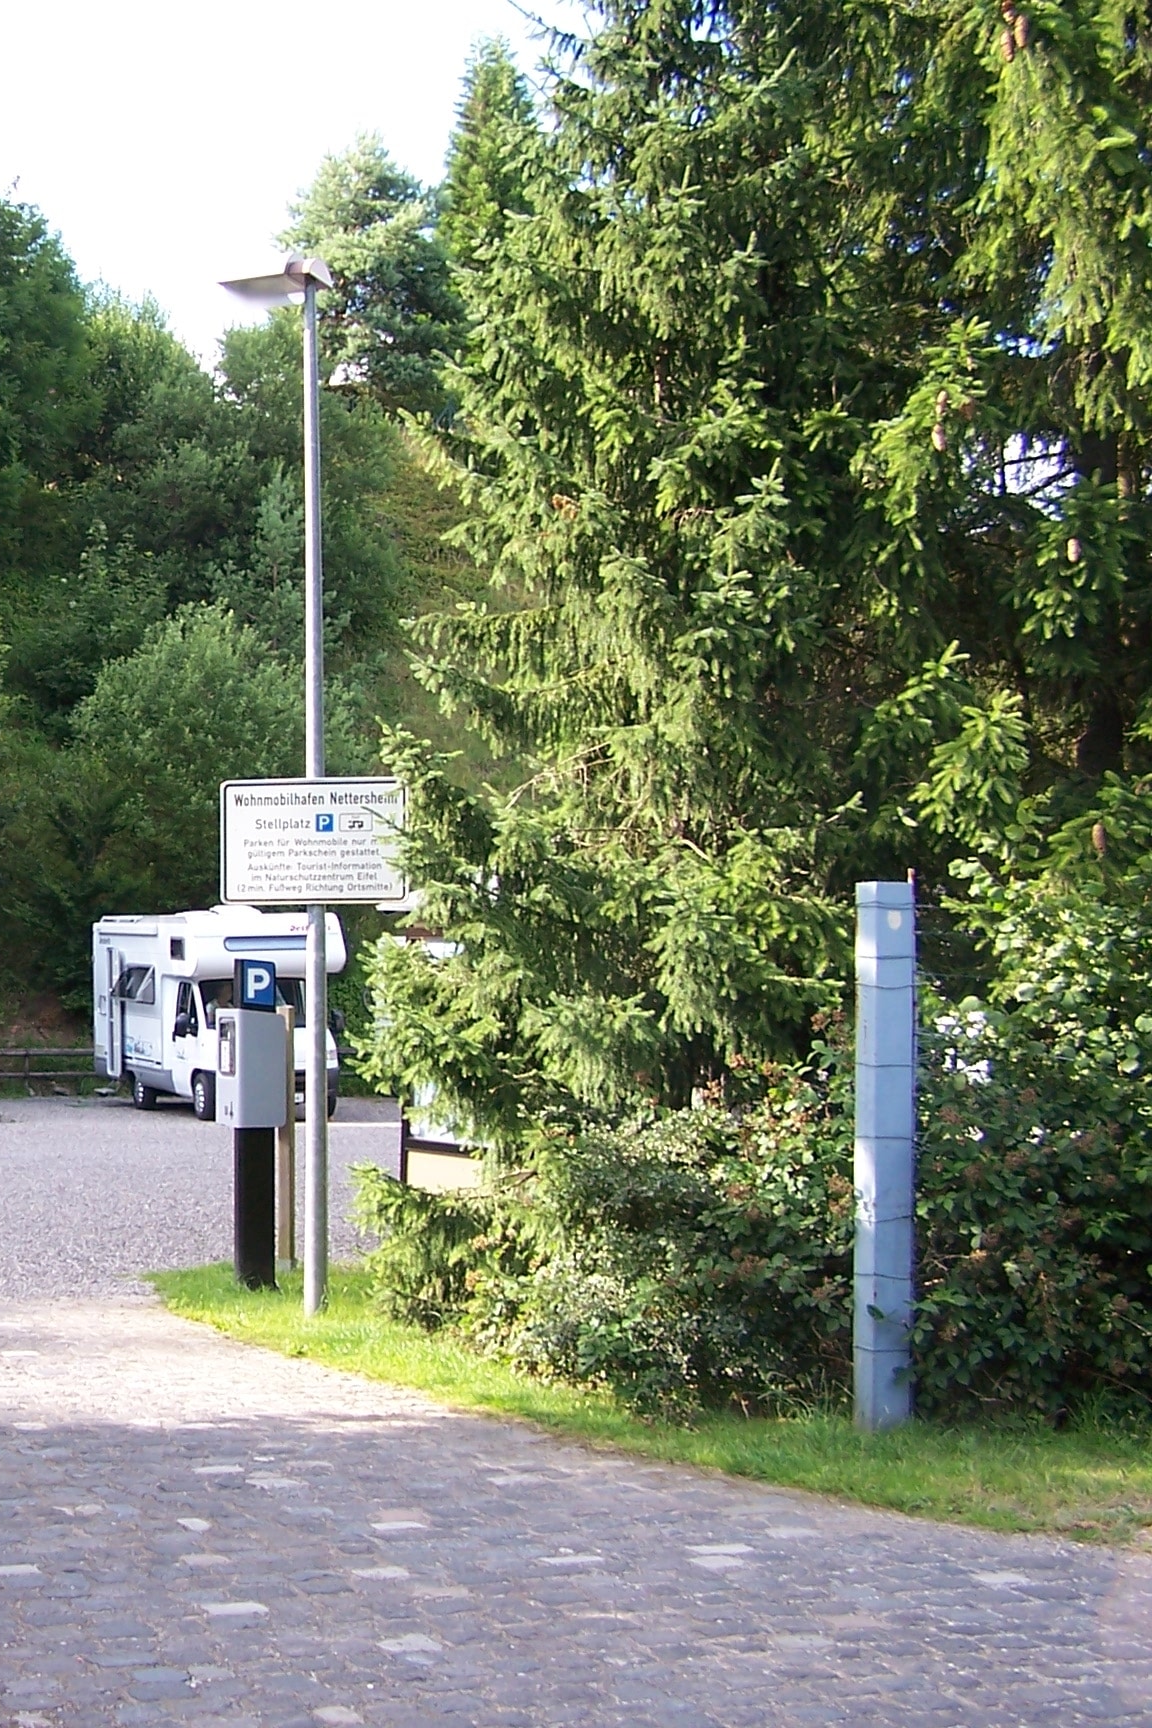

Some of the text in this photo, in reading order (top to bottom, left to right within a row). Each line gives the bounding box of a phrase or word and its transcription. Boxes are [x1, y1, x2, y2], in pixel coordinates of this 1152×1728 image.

[234, 792, 324, 807] Wohnmobilhafen
[255, 816, 329, 831] Stellplatz P
[244, 839, 273, 847] Parken
[294, 838, 348, 846] Wohnmobile
[288, 849, 336, 857] Parkschein
[297, 862, 382, 870] Tourist-Information
[306, 883, 344, 892] Richtung
[248, 968, 270, 999] P
